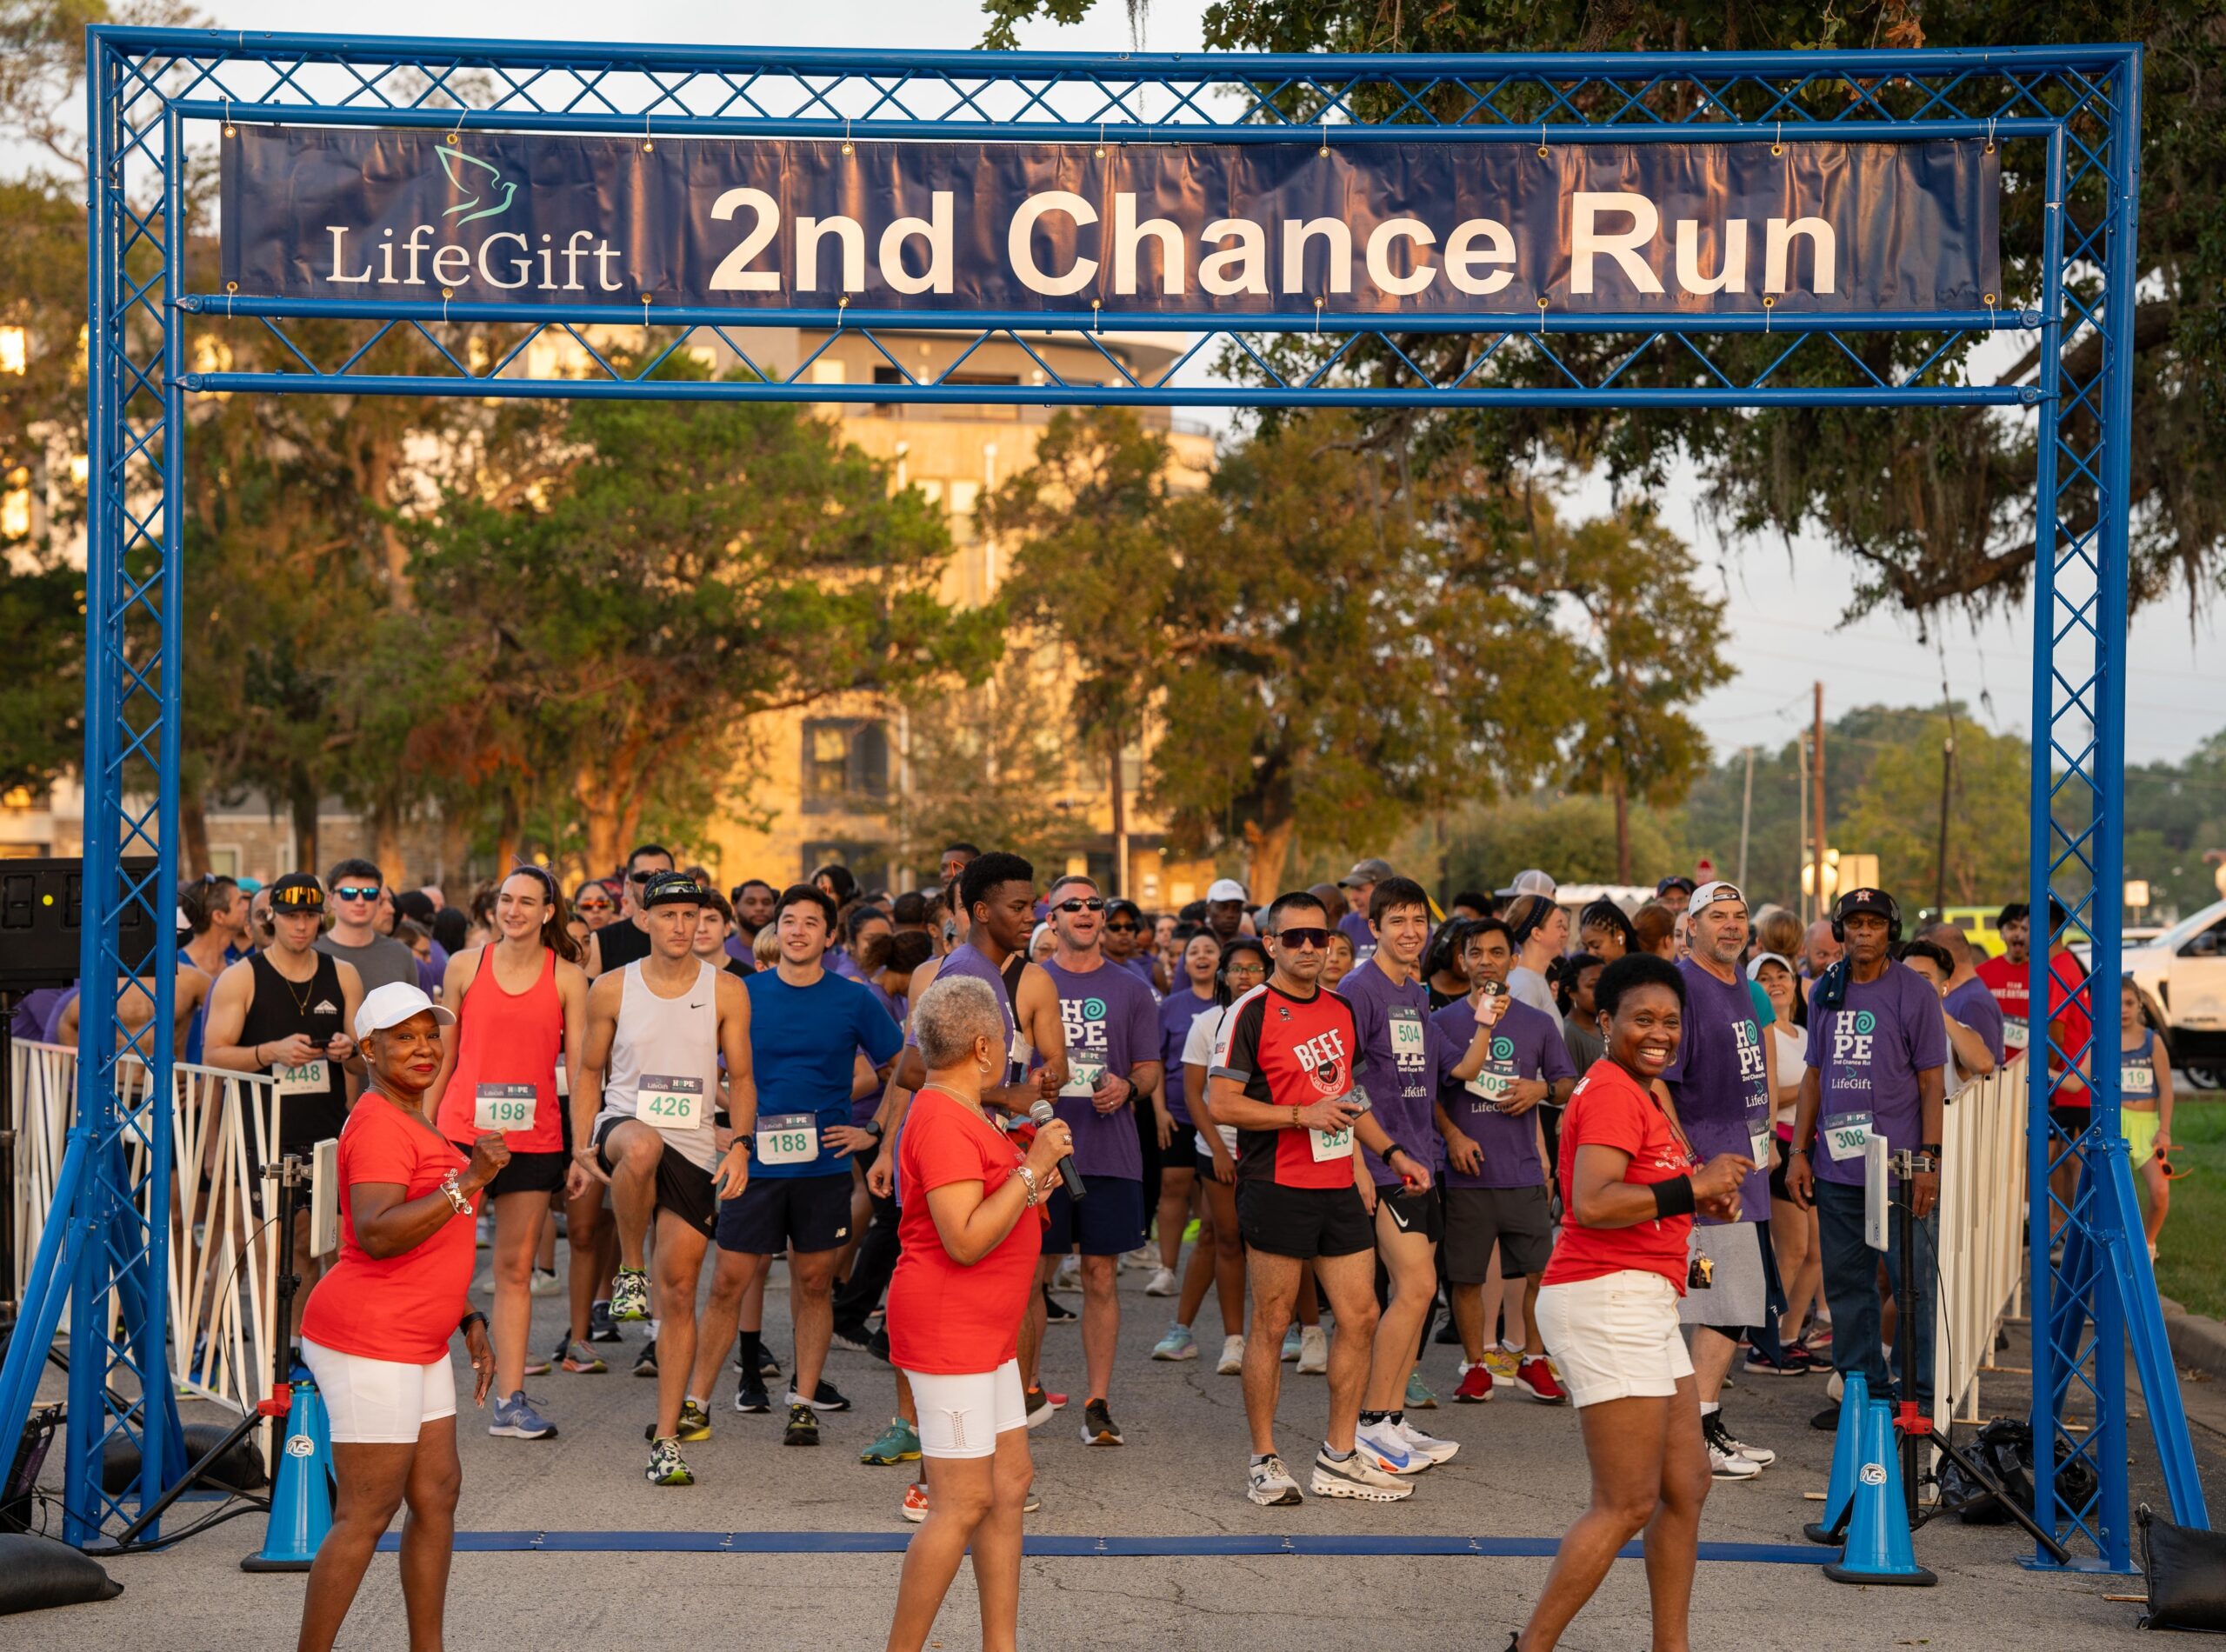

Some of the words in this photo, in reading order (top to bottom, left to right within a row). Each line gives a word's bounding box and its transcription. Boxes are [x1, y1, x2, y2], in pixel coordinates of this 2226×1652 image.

[709, 187, 956, 296] 2nd
[1007, 190, 1516, 296] Chance
[1570, 191, 1837, 296] Run
[325, 223, 623, 292] LifeGift
[1398, 1024, 1420, 1042] 504
[2003, 1026, 2023, 1041] 95
[1293, 1028, 1345, 1072] BEEF
[285, 1064, 321, 1082] 448
[1831, 1078, 1872, 1089] LifeGift
[489, 1102, 525, 1120] 198
[649, 1096, 690, 1116] 426
[1471, 1102, 1508, 1113] LifeG
[770, 1134, 807, 1153] 188
[1322, 1129, 1349, 1148] 523
[1836, 1129, 1865, 1149] 308
